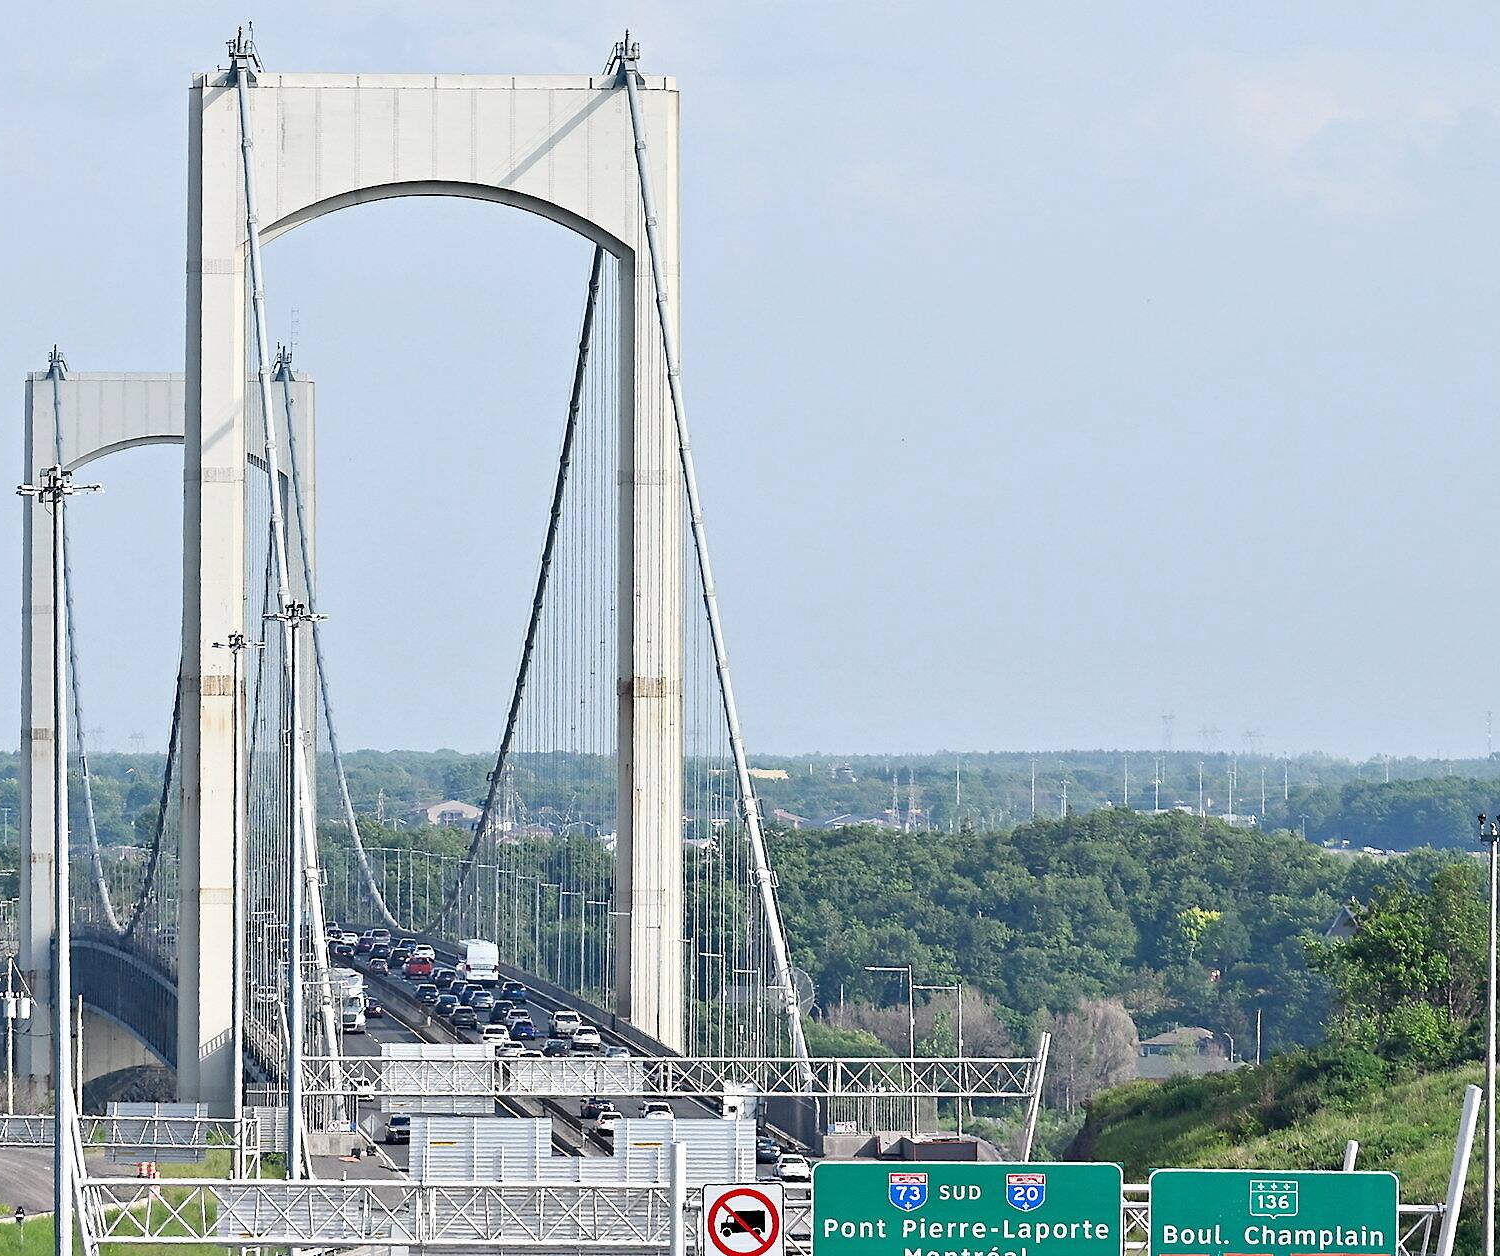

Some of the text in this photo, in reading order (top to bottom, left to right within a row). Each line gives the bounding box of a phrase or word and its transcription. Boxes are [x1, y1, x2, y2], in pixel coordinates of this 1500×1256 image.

[895, 1185, 1039, 1202] 73 SUD 20
[1257, 1194, 1290, 1209] 136
[823, 1219, 1110, 1244] Pont Pierre-Laporte
[1162, 1225, 1385, 1251] Boul. Champlain
